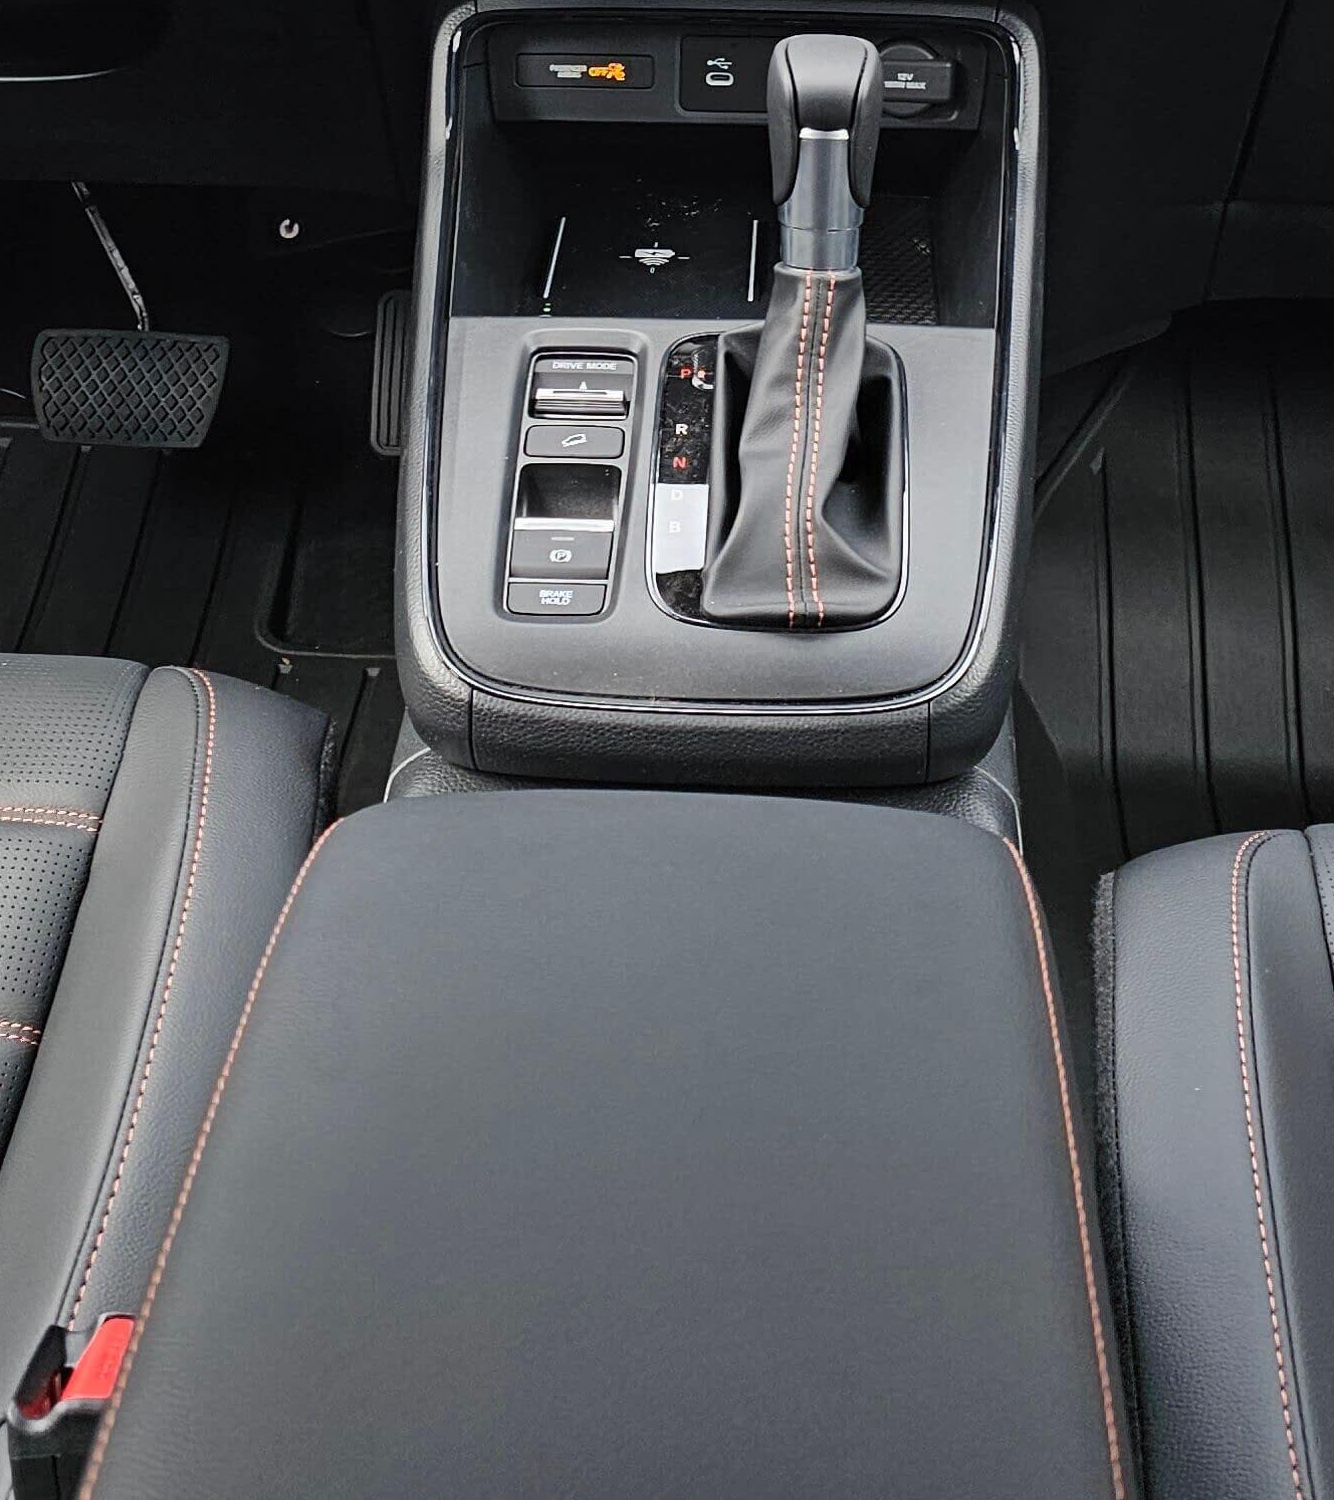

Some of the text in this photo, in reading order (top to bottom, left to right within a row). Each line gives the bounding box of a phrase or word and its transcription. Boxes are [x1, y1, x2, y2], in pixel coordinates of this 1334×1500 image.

[552, 360, 618, 371] DRIVE MODE
[675, 423, 689, 436] R
[672, 456, 687, 469] N
[671, 489, 683, 501] D
[669, 521, 681, 533] B
[539, 589, 574, 598] BRAKE
[540, 597, 571, 606] HOLD
